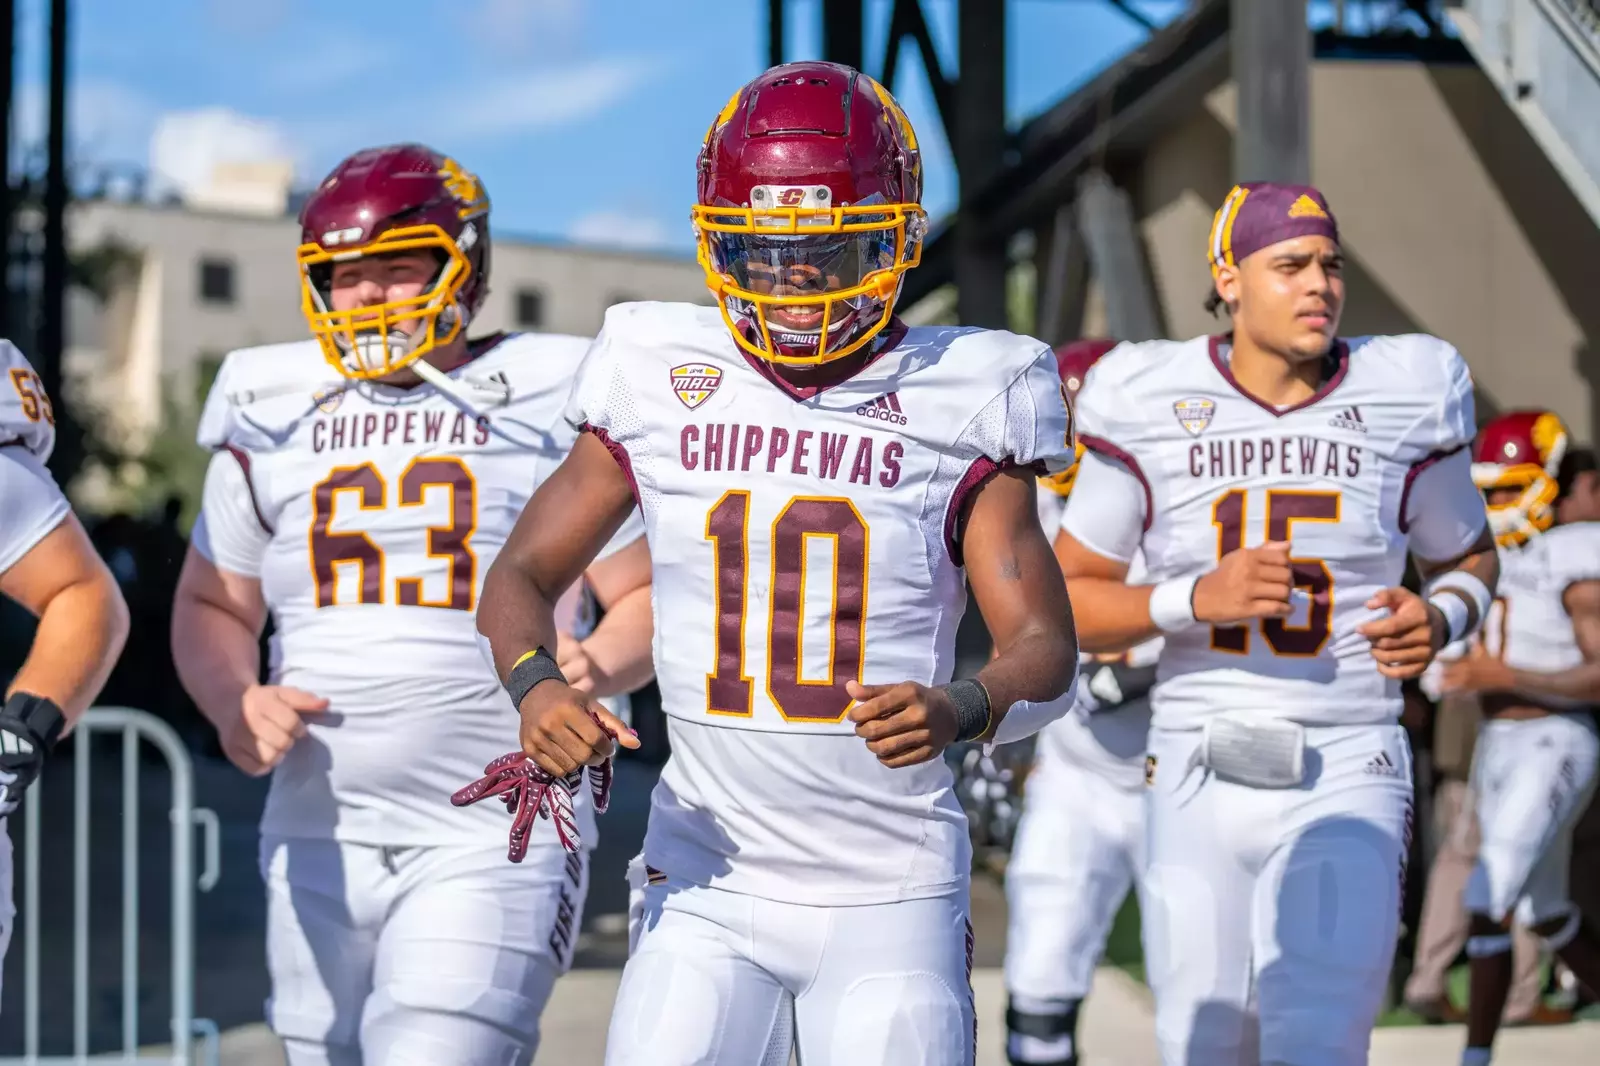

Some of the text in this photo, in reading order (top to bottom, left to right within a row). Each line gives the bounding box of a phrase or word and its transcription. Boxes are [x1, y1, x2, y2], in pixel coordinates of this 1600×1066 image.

[672, 377, 721, 390] MAC
[312, 410, 491, 454] CHIPPEWAS
[856, 406, 908, 426] adidas
[680, 423, 904, 488] CHIPPEWAS
[1189, 437, 1362, 478] CHIPPEWAS
[308, 456, 479, 613] 63
[1210, 488, 1342, 659] 15
[704, 489, 870, 724] 10
